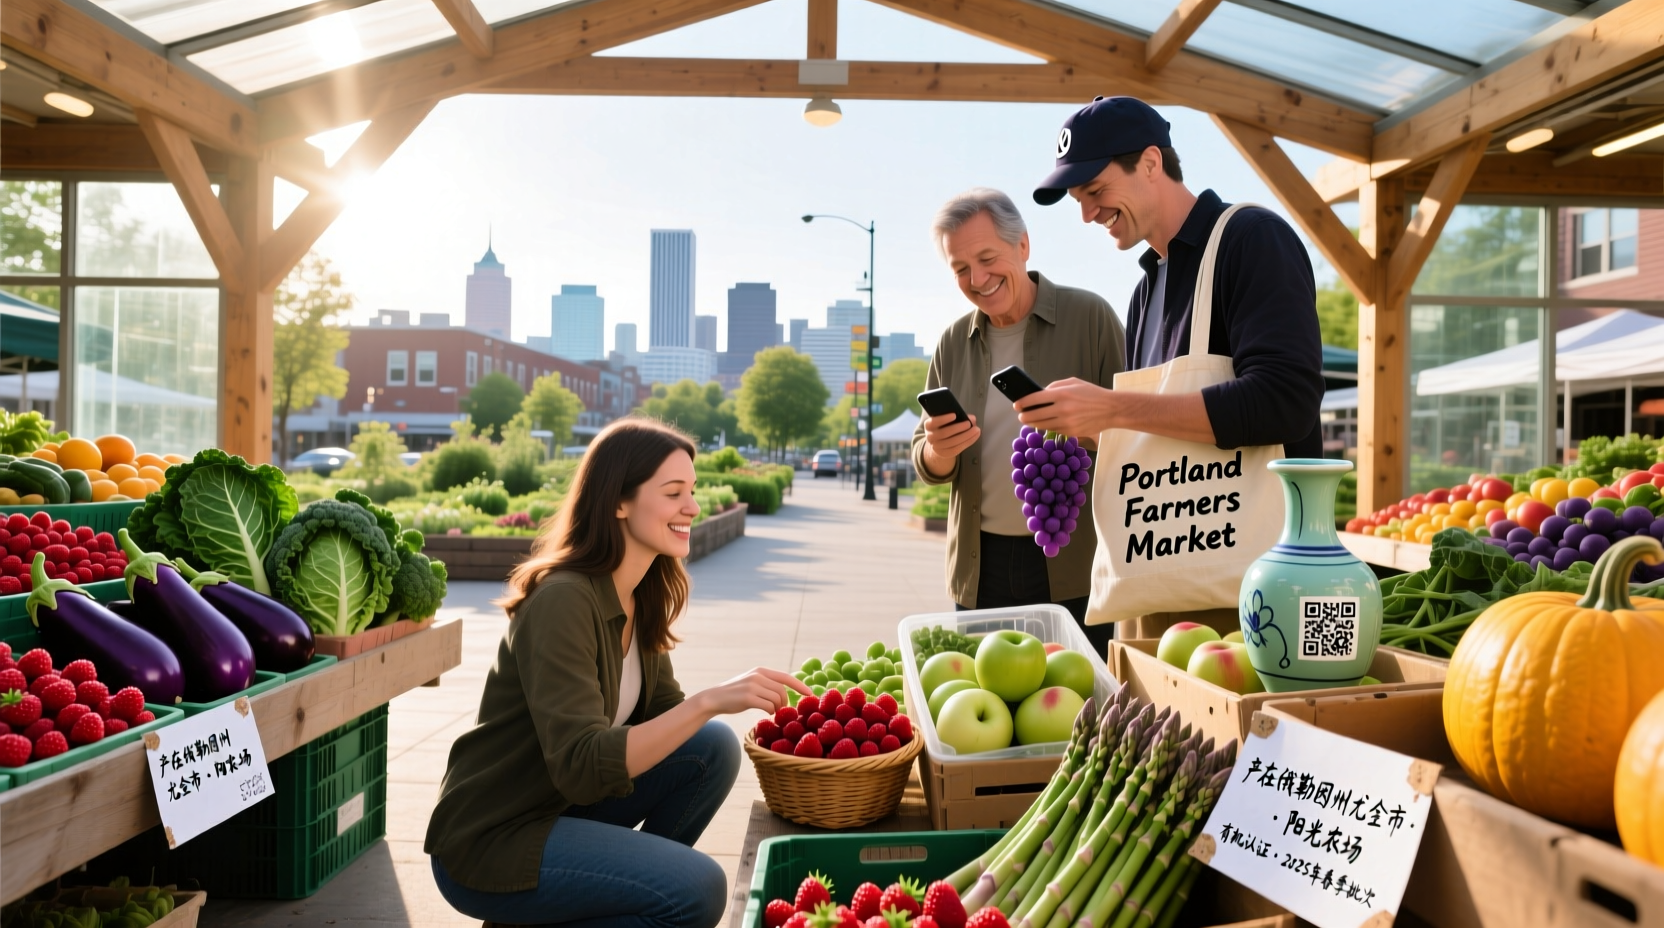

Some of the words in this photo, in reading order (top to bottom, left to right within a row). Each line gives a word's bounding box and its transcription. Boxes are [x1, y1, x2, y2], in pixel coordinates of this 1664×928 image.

[1119, 451, 1242, 495] Portland
[1125, 492, 1240, 528] Farmers
[1126, 523, 1236, 563] Market
